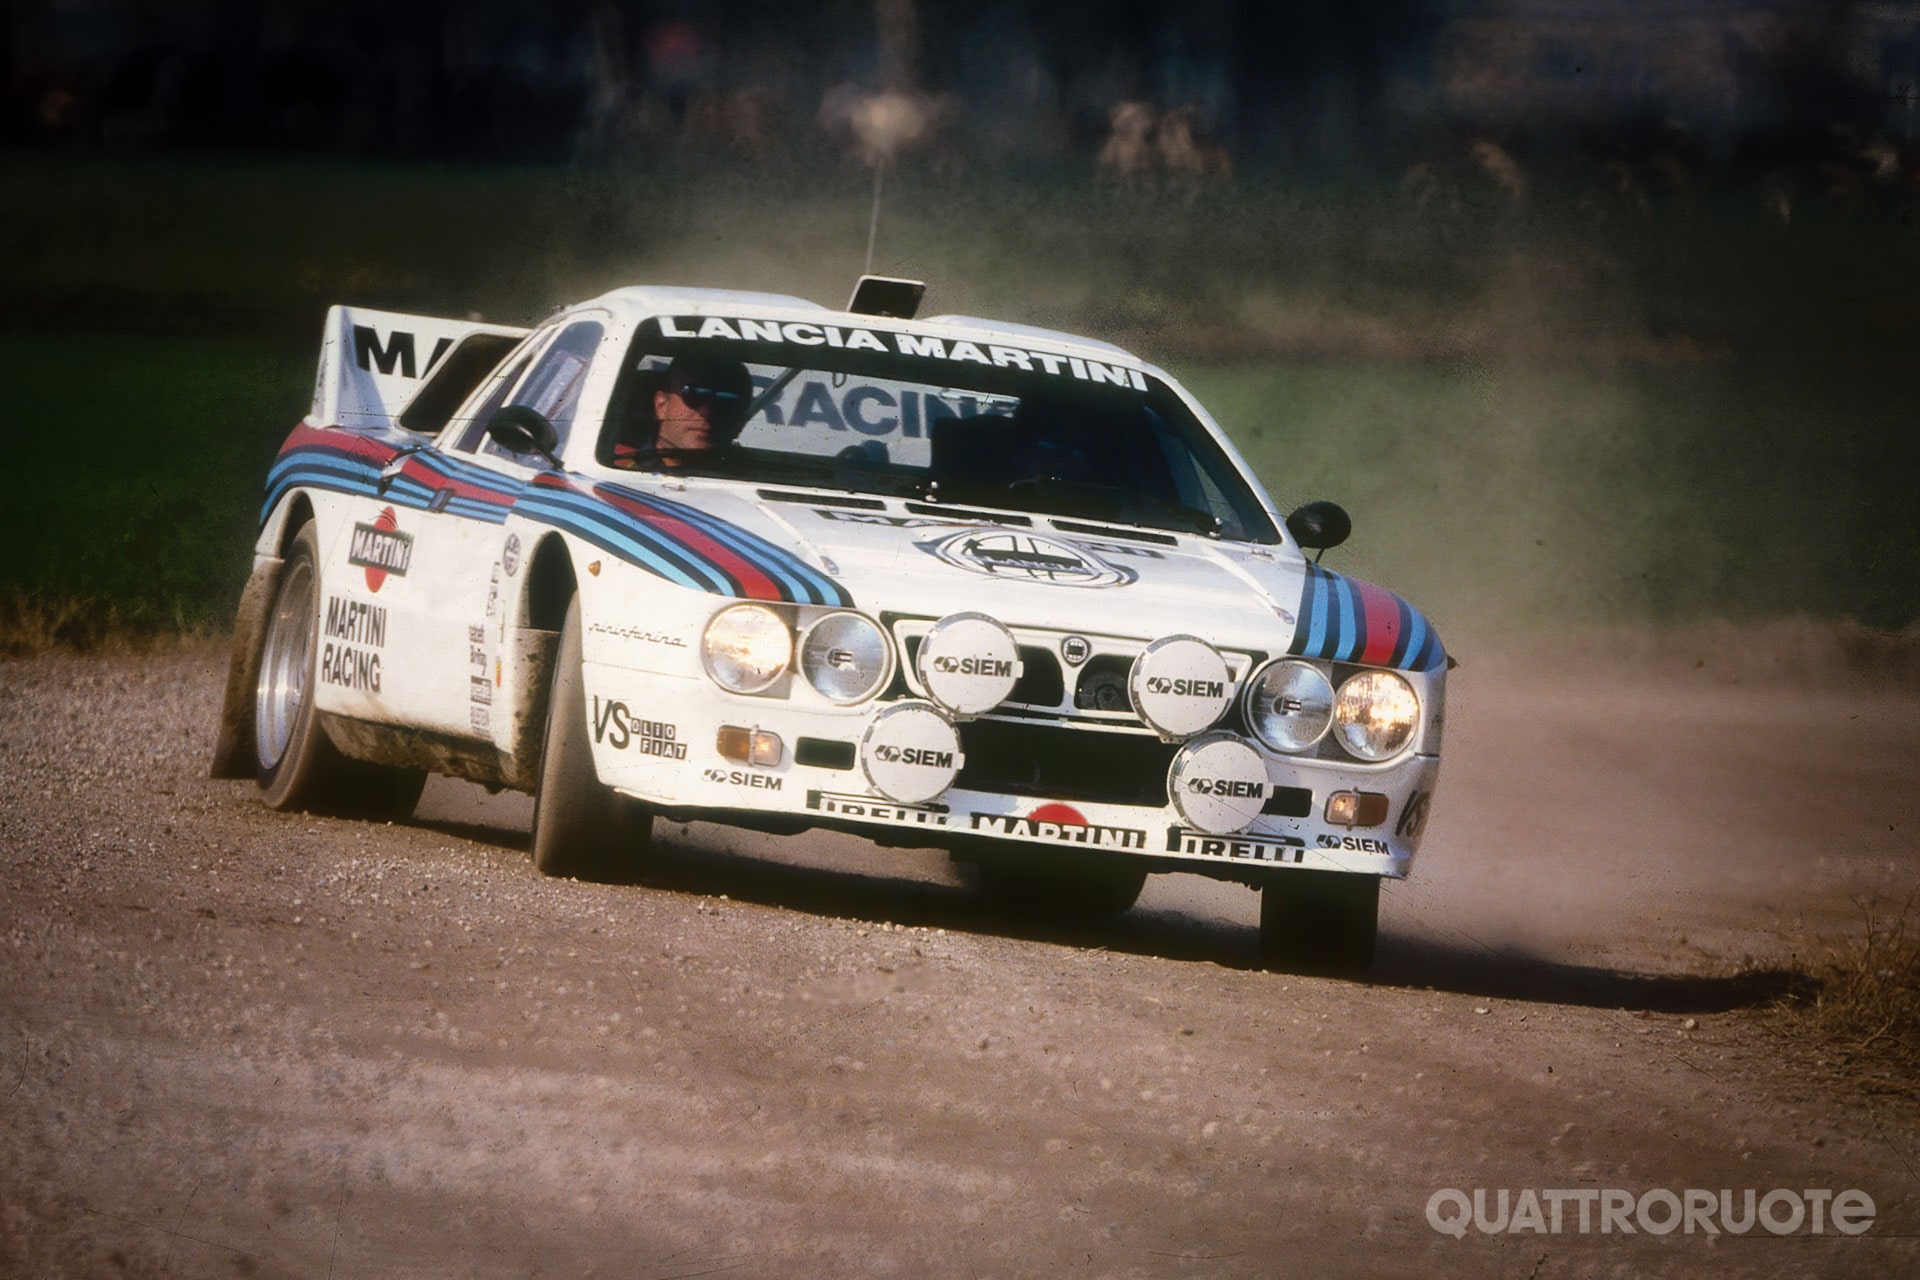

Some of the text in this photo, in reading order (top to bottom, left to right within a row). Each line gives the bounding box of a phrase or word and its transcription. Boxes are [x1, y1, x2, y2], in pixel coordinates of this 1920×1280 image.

[658, 315, 1148, 391] LANCIA MARTINI
[351, 529, 412, 571] MARTINI
[325, 597, 386, 648] MARTINI
[322, 643, 381, 693] RACING
[961, 658, 1012, 677] SIEM
[1172, 678, 1224, 698] SIEM
[594, 695, 630, 749] VS
[641, 738, 688, 759] FIAT
[902, 748, 953, 768] SIEM
[729, 771, 782, 791] SIEM
[1214, 779, 1264, 799] SIEM
[978, 816, 1139, 849] MARTINI
[1166, 825, 1306, 863] PIRELLI
[1341, 836, 1390, 855] SIEM
